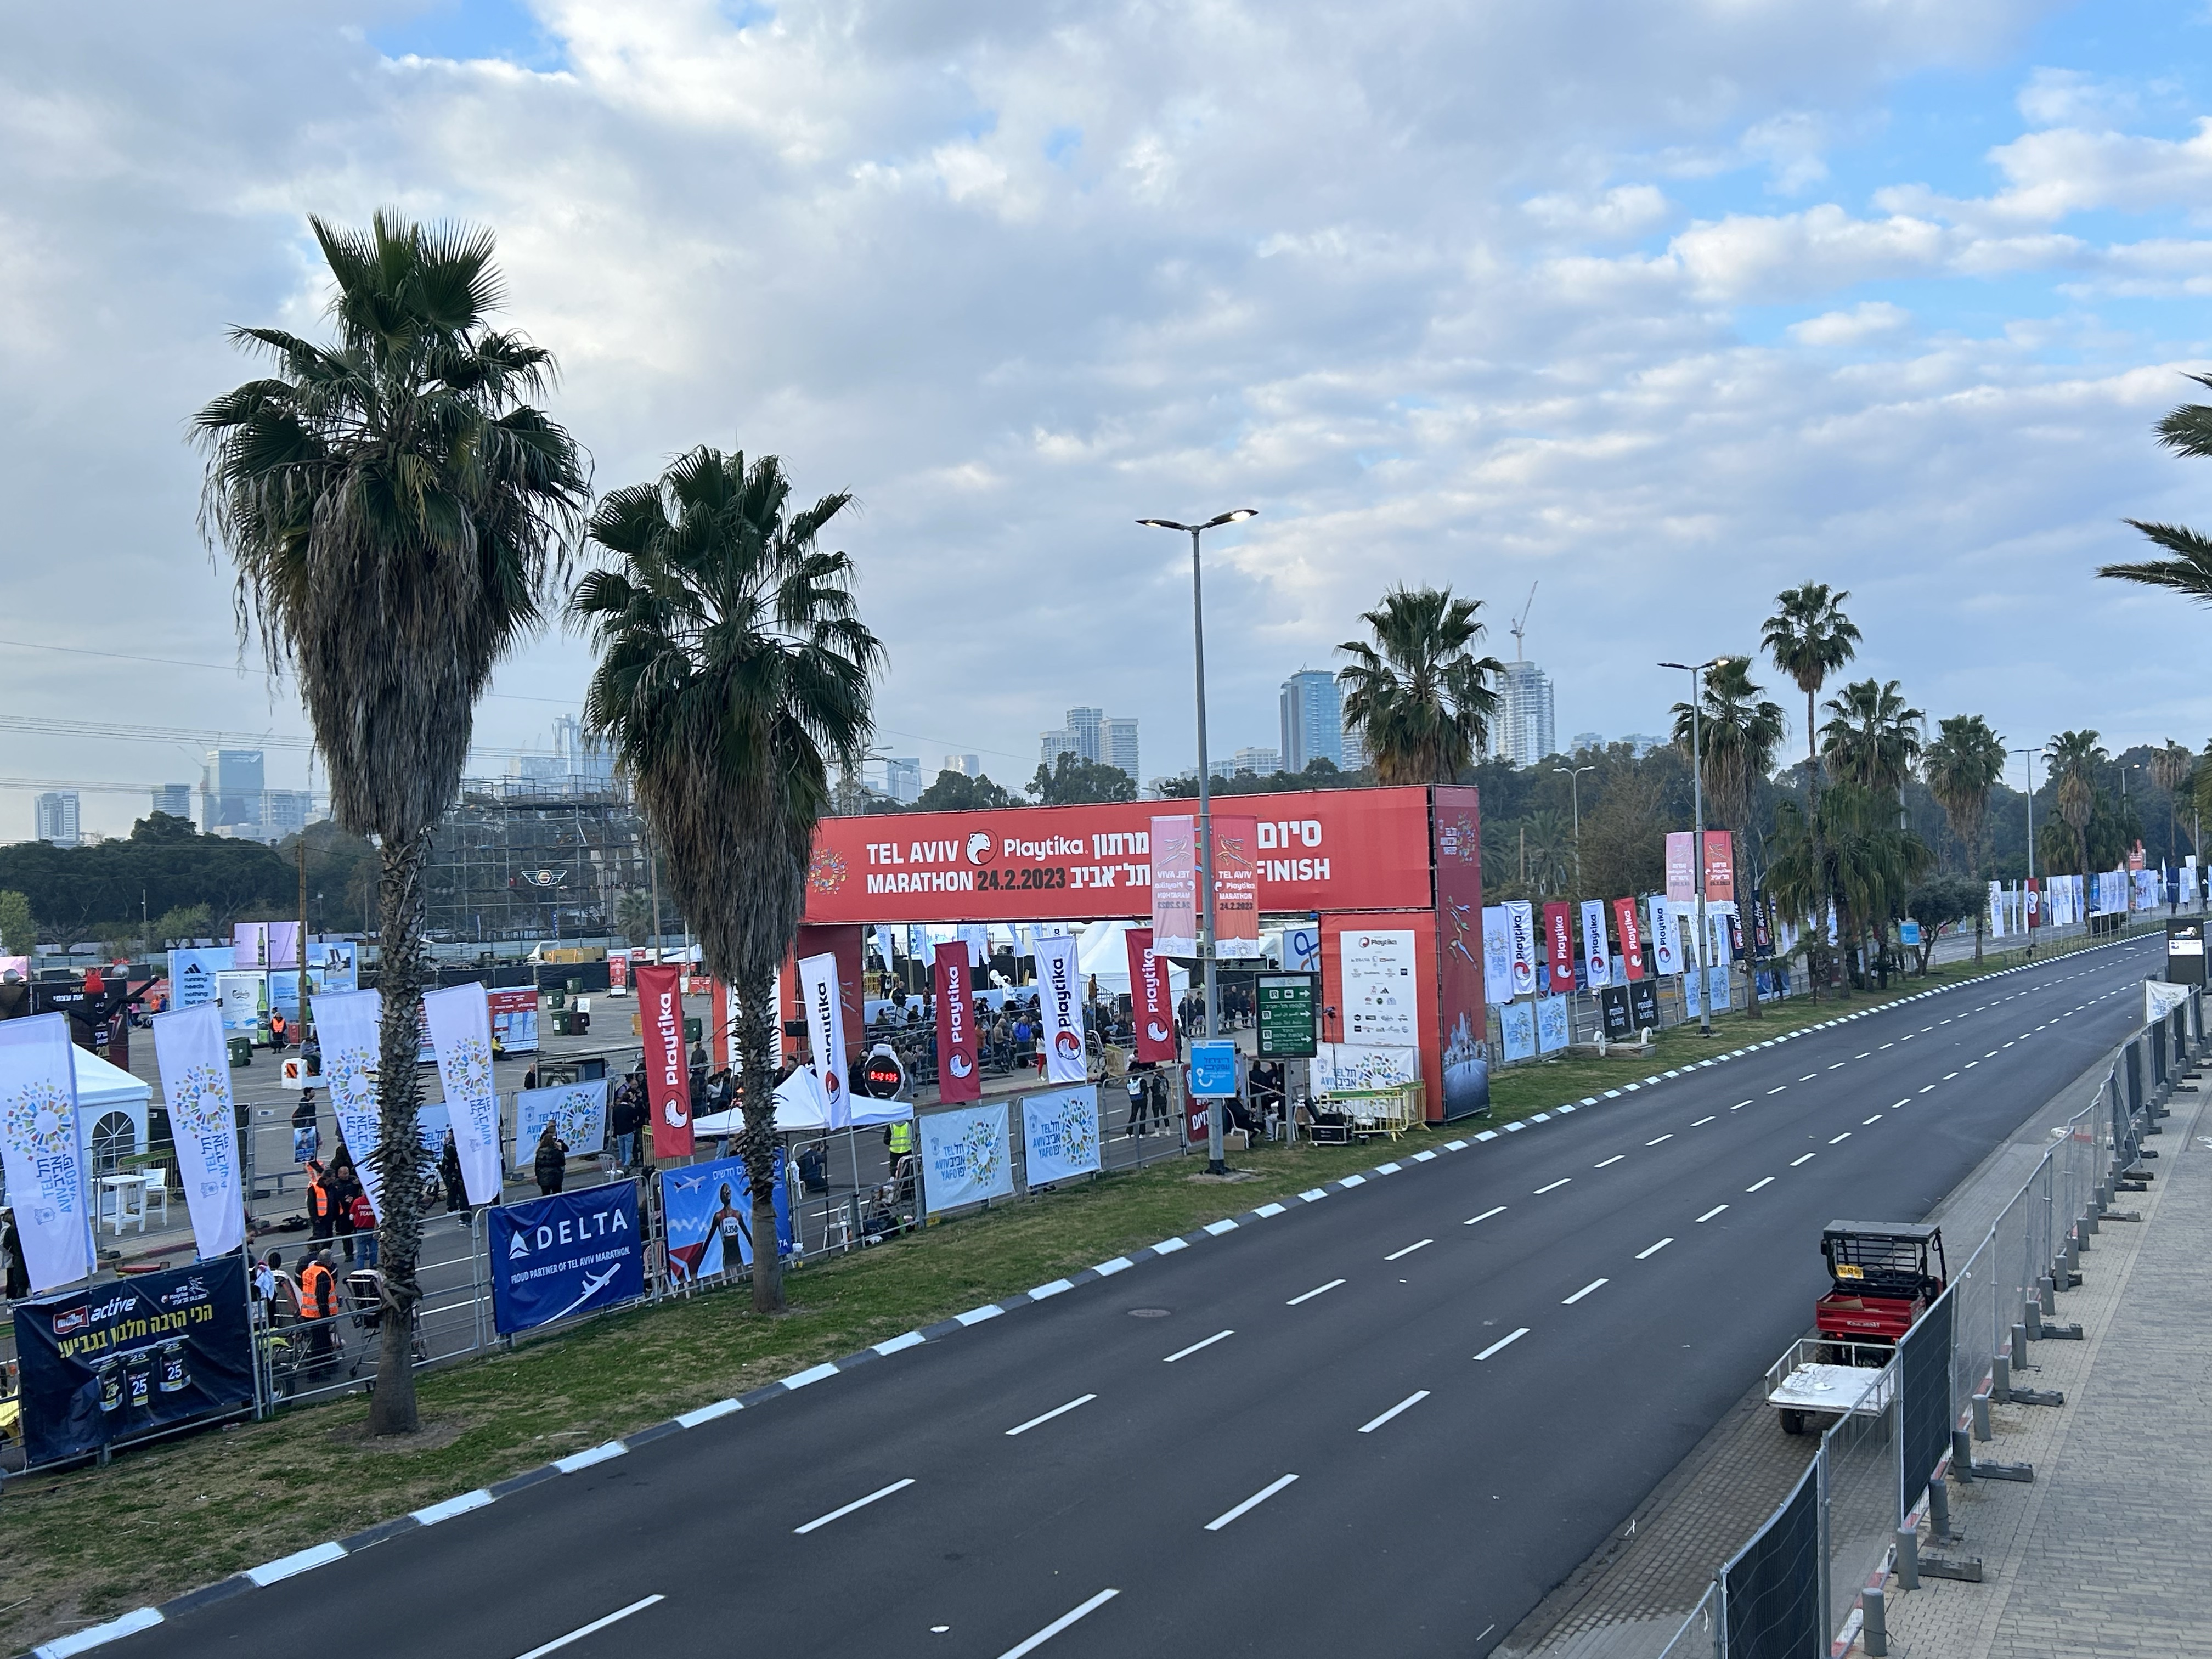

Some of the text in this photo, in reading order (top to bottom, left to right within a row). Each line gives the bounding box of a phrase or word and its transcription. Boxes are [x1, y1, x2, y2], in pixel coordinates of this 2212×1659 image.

[1257, 820, 1322, 849] סיום
[866, 832, 1149, 865] TEL AVIV Playtika מרתון
[867, 871, 973, 894] MARATHON
[977, 867, 1066, 891] 24.2.2023
[1226, 882, 1255, 890] Playtika
[1234, 871, 1252, 879] AVIV
[1514, 915, 1526, 959] Playtika
[1554, 915, 1567, 959] Playtika
[1590, 914, 1600, 955] Playtika
[1624, 910, 1637, 950] Playtika
[1657, 908, 1667, 945] Playtika
[1052, 958, 1071, 1028] Playtika
[1142, 948, 1160, 1013] Playtika
[947, 966, 964, 1043] Playtika
[657, 992, 679, 1085] Playtika
[1333, 1066, 1356, 1077] TEL תל
[1336, 1077, 1357, 1087] אביב
[476, 1098, 489, 1124] אביב
[539, 1113, 549, 1122] TEL
[345, 1116, 357, 1151] TEL תל
[357, 1115, 368, 1142] אביב
[1032, 1132, 1060, 1148] AVIV אביב
[1041, 1120, 1060, 1134] TEL תל
[63, 1153, 74, 1171] יפו
[201, 1136, 217, 1174] TEL תל
[212, 1134, 225, 1163] אביב
[943, 1142, 964, 1156] TEL תל
[1039, 1146, 1053, 1159] YAFO
[935, 1155, 966, 1171] AVIV אביב
[941, 1166, 967, 1181] YAFO יפו
[36, 1158, 55, 1199] TEL תל
[50, 1155, 72, 1212] AVIV אביב
[537, 1209, 628, 1250] DELTA
[724, 1224, 738, 1234] A350
[511, 1271, 529, 1285] PROUD
[529, 1265, 558, 1279] PARTNER
[558, 1262, 567, 1272] OF
[567, 1258, 579, 1269] TEL
[579, 1254, 595, 1267] AVIV
[90, 1296, 137, 1322] active
[150, 1310, 187, 1334] הרבה
[190, 1304, 213, 1323] הכי
[57, 1330, 108, 1359] בגביע!
[129, 1353, 147, 1363] 25
[167, 1364, 183, 1380] 25
[132, 1378, 148, 1396] 25
